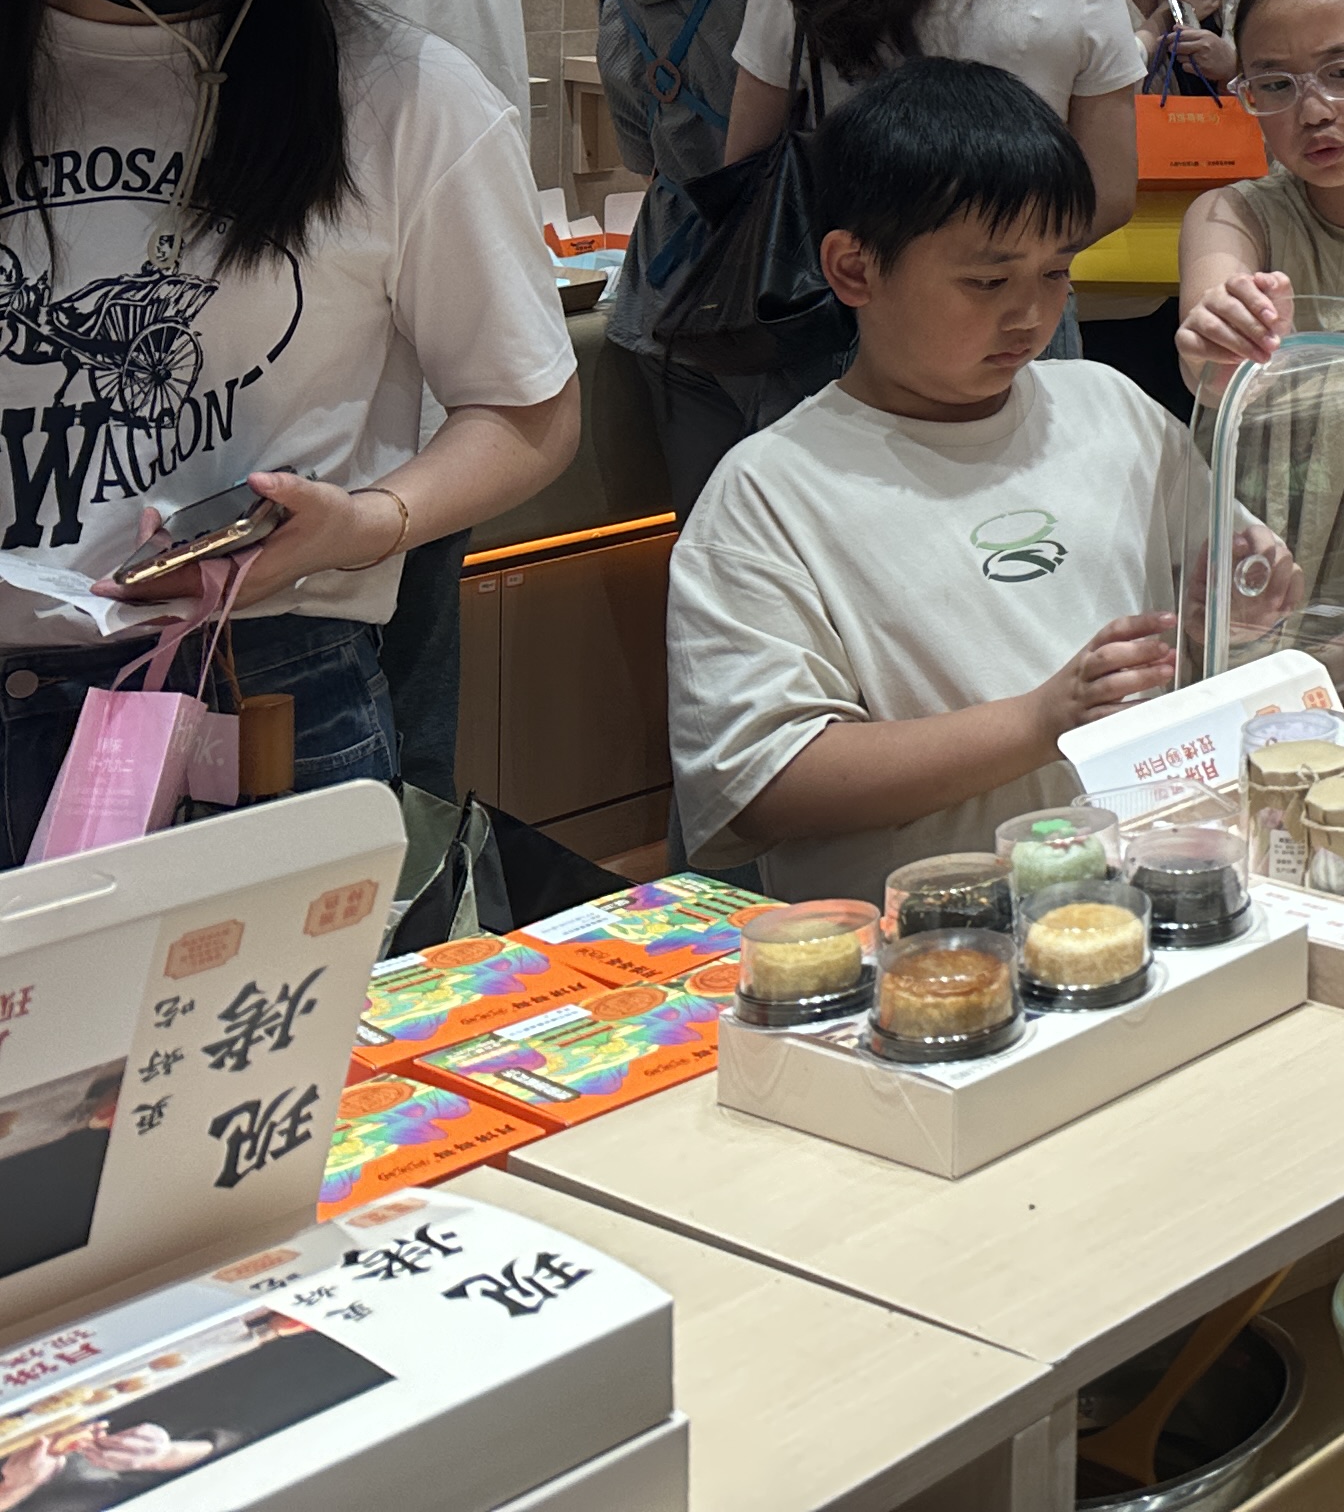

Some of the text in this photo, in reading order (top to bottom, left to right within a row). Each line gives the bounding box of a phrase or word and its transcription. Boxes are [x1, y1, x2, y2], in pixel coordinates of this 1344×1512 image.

[137, 994, 195, 1136] 更好吃
[201, 964, 328, 1189] 现烤
[341, 1221, 597, 1319] 现烤
